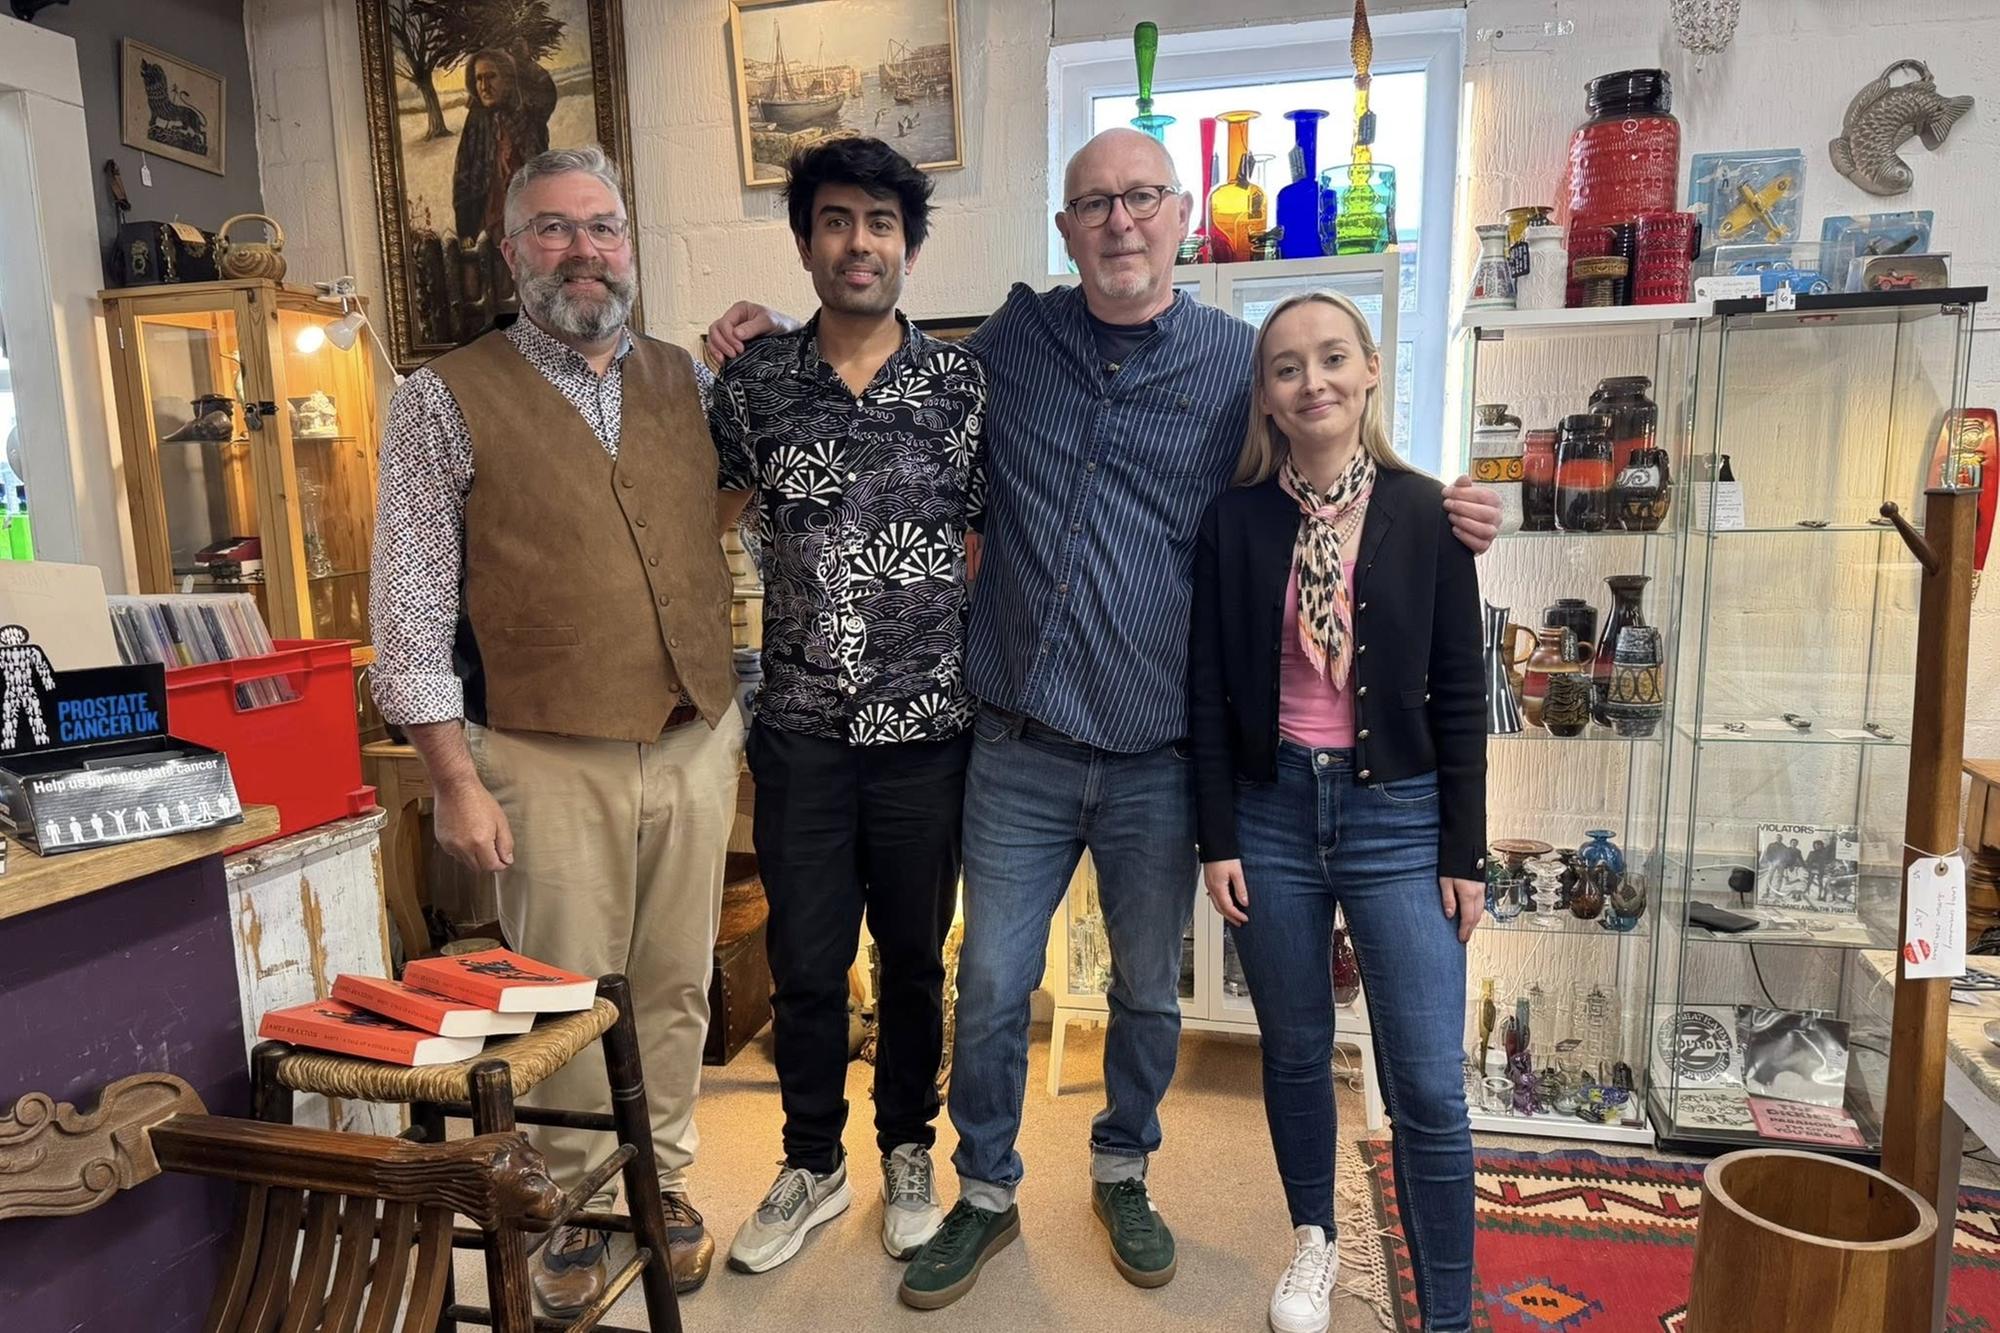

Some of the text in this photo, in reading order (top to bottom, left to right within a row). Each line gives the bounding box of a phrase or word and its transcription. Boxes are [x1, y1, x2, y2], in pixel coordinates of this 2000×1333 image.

[58, 693, 148, 721] PROSTATE
[60, 711, 160, 742] CANCER UK
[32, 780, 66, 795] Help
[68, 776, 86, 790] us
[120, 765, 175, 784] prostate
[176, 758, 219, 774] cancer
[1759, 824, 1814, 834] VIOLATORS
